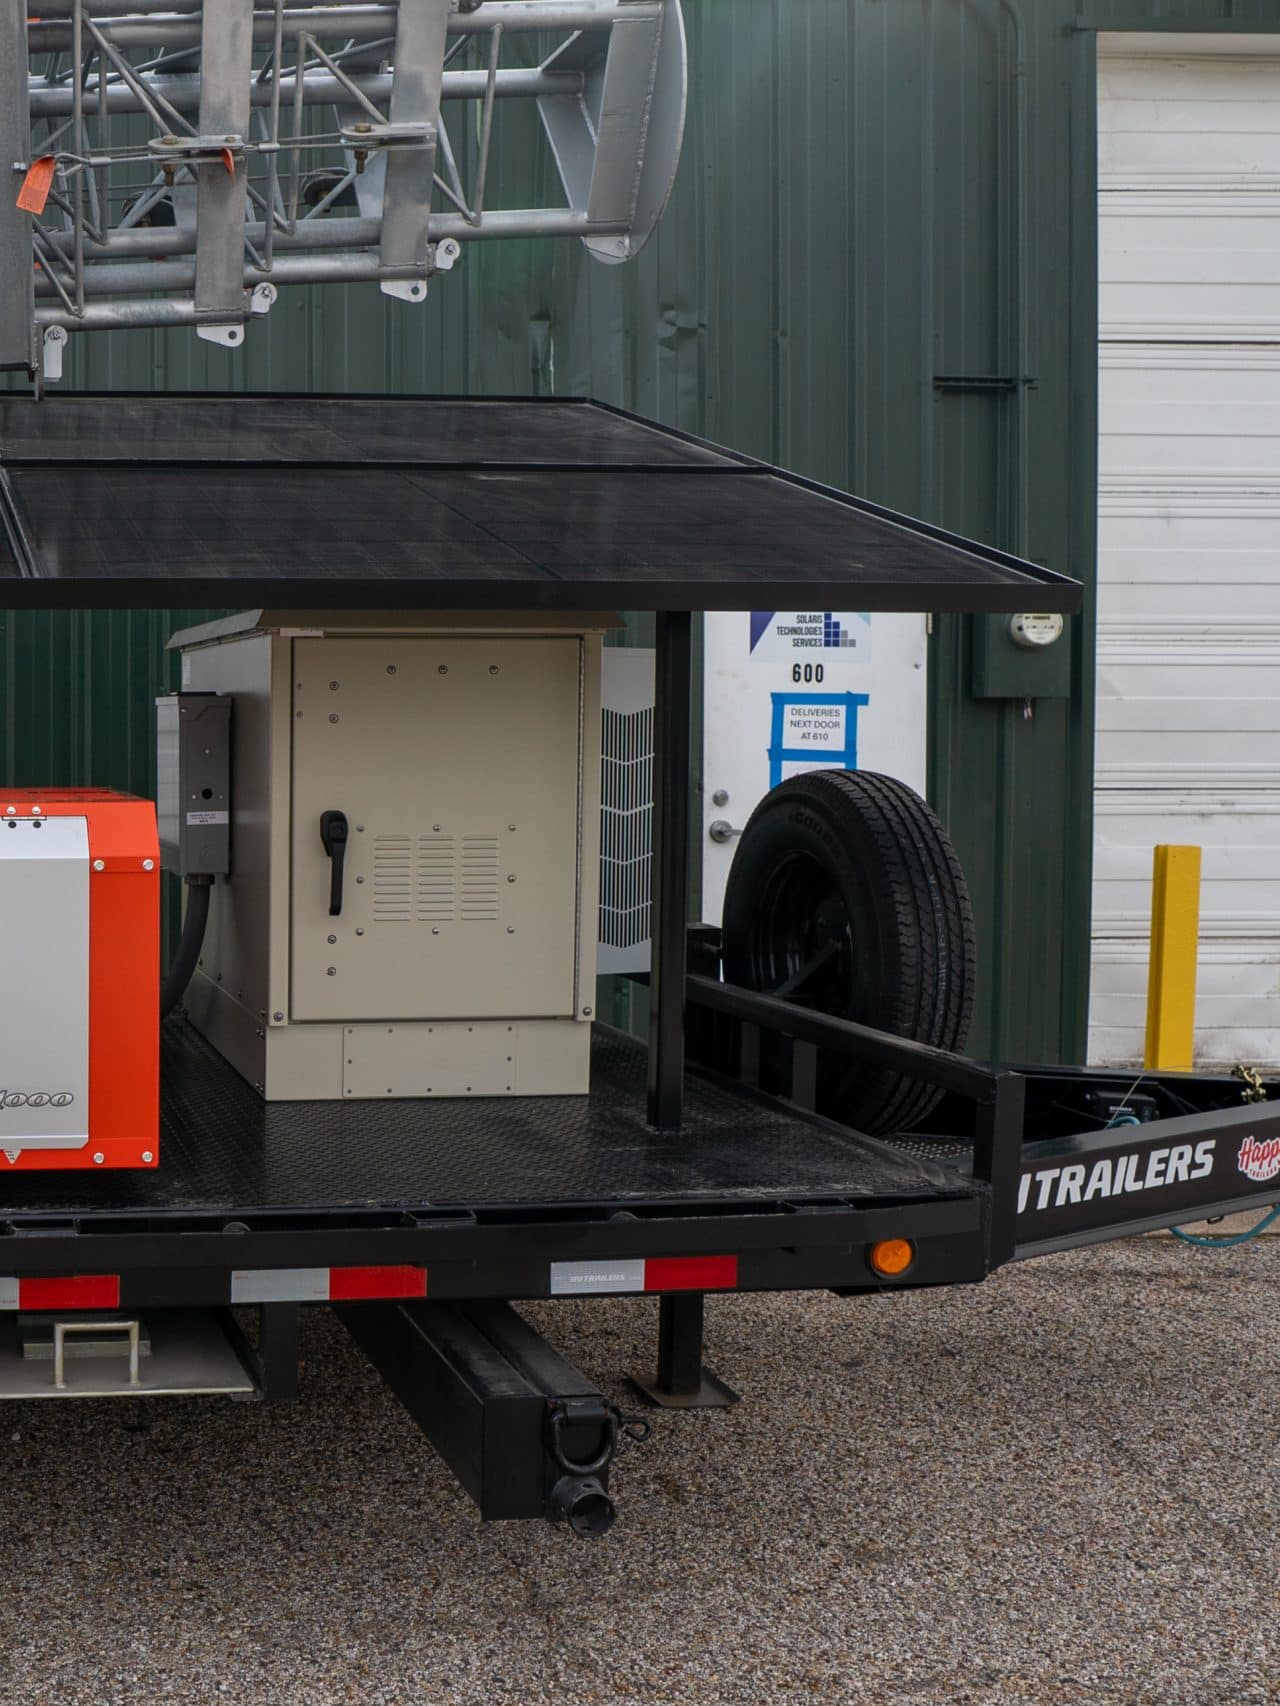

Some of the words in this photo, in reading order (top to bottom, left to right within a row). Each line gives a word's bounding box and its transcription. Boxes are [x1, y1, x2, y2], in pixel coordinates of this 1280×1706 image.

[796, 614, 823, 624] SOLARIS
[776, 626, 823, 636] TECHNOLOGIES
[792, 638, 823, 648] SERVICES
[792, 663, 824, 683] 600
[790, 708, 840, 717] DELIVERIES
[790, 720, 812, 728] NEXT
[814, 720, 841, 729] DOOR
[801, 732, 812, 740] AT
[813, 732, 829, 741] 610
[1238, 1136, 1280, 1172] Happ
